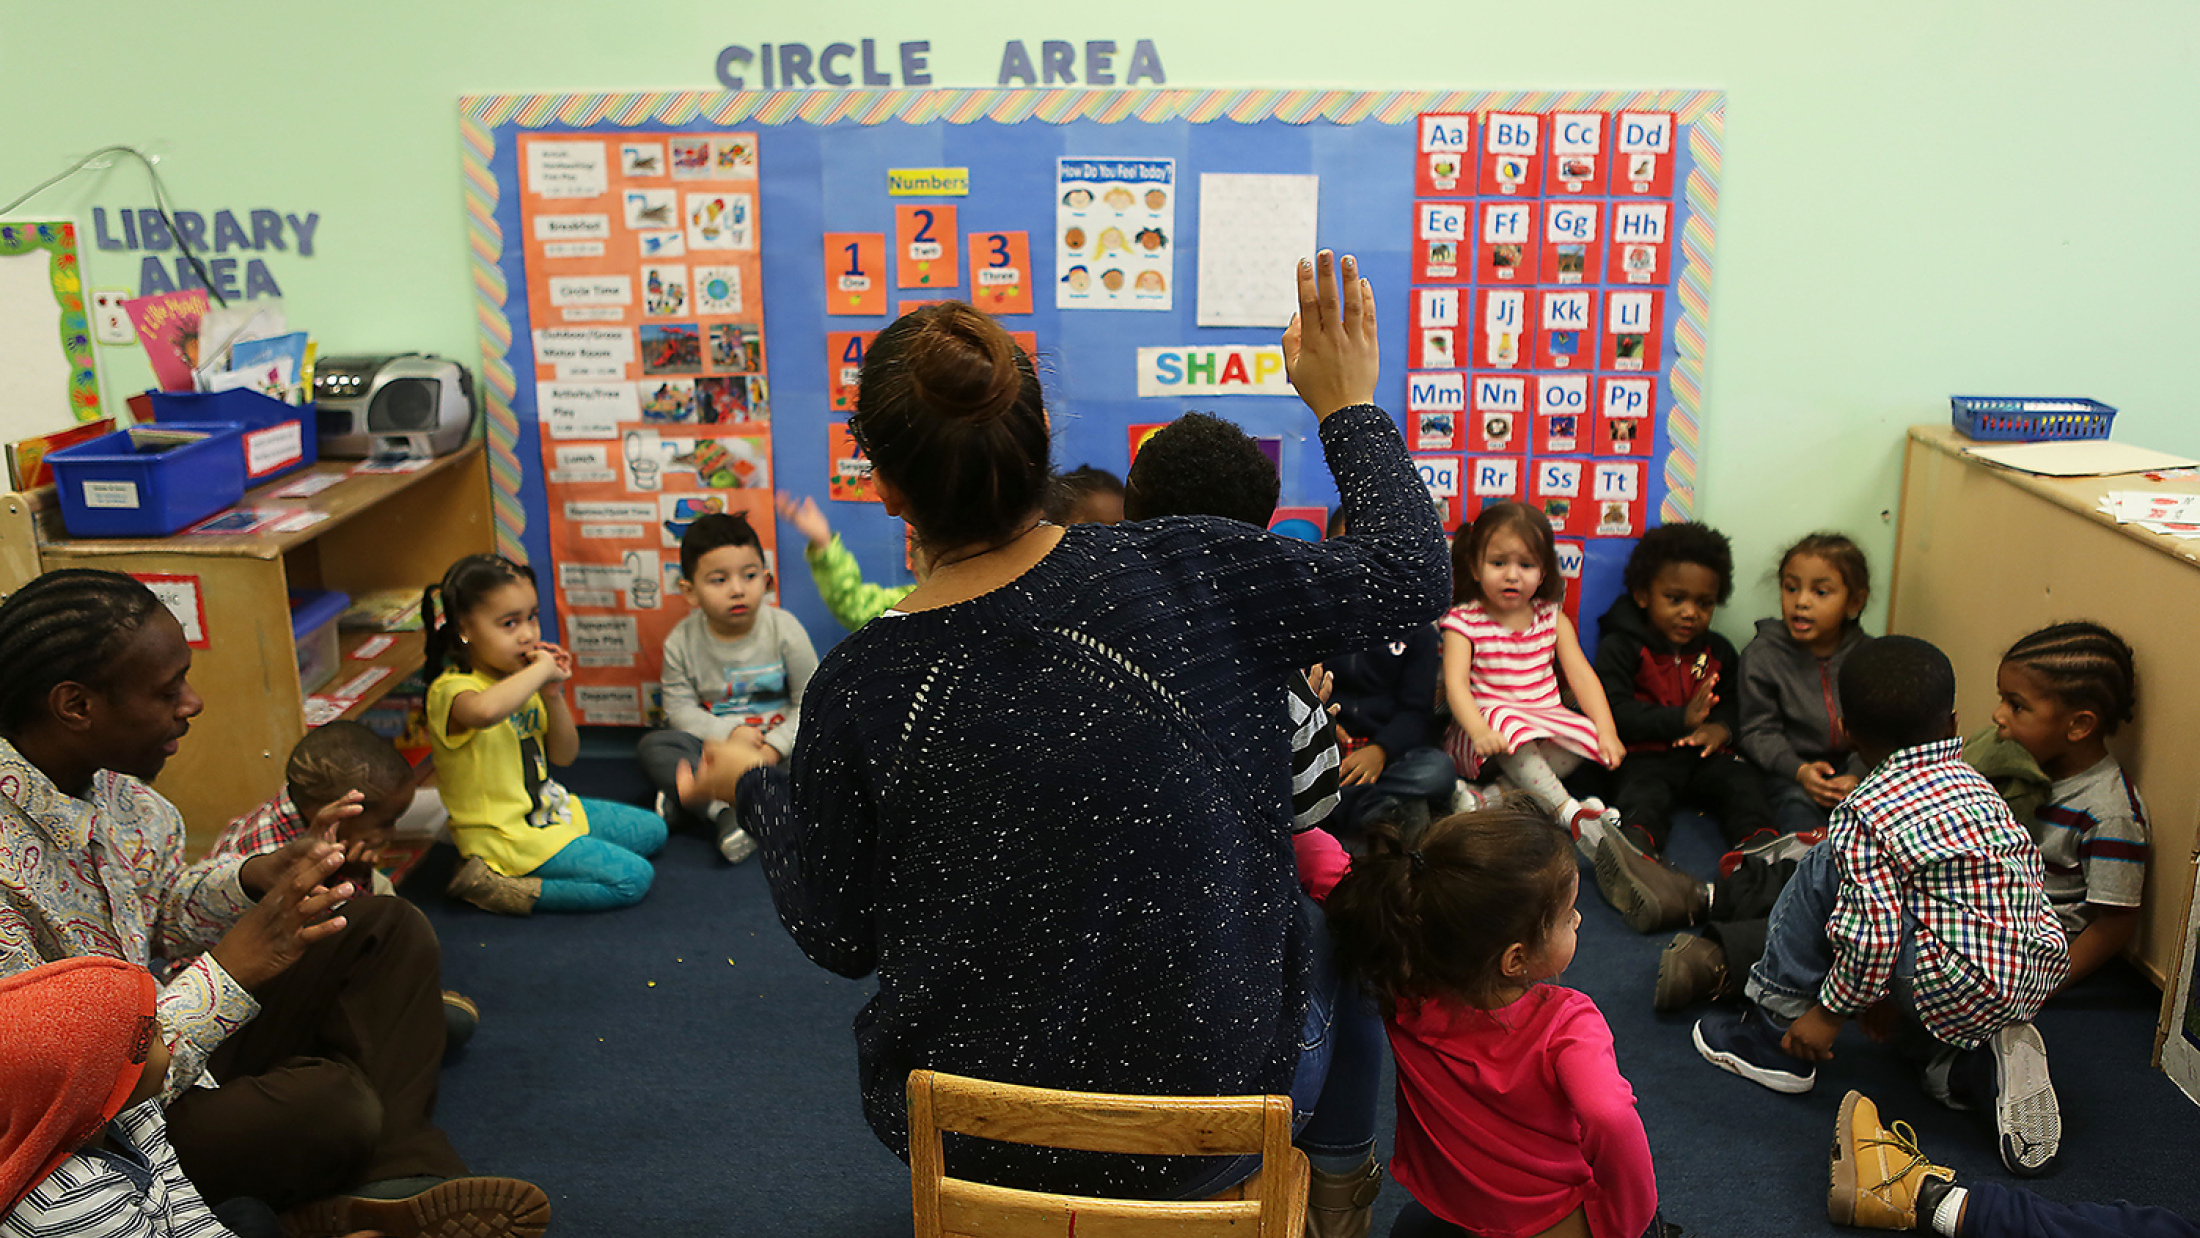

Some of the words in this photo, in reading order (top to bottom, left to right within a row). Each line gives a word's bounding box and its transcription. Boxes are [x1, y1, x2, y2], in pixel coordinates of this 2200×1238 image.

[715, 38, 933, 90] CIRCLE
[998, 39, 1167, 86] AREA
[1430, 124, 1464, 146] Aa
[1497, 123, 1531, 147] Bb
[1564, 122, 1594, 145] Cc
[1626, 123, 1662, 147] Dd
[889, 174, 969, 190] Numbers
[1060, 163, 1082, 178] How
[1083, 163, 1098, 178] Do
[1099, 163, 1117, 178] You
[1118, 163, 1138, 179] Feel
[93, 206, 320, 257] LIBRARY
[549, 221, 600, 232] Breakfast
[913, 209, 936, 243] 2
[1429, 210, 1459, 232] Ee
[1495, 212, 1519, 234] Ff
[1554, 210, 1588, 238] Gg
[1623, 213, 1657, 236] Hh
[844, 243, 865, 276] 1
[914, 247, 937, 257] Two
[988, 234, 1010, 268] 3
[139, 256, 282, 301] AREA
[843, 278, 866, 288] One
[983, 271, 1015, 280] Three
[1496, 299, 1515, 326] Jj
[1551, 299, 1582, 321] Kk
[843, 336, 864, 367] 4
[1156, 352, 1291, 385] SHAP
[1412, 384, 1461, 404] Mm
[1482, 383, 1517, 404] Nn
[1546, 386, 1582, 407] Oo
[1611, 386, 1642, 412] Pp
[564, 455, 595, 464] Lunch
[1418, 465, 1452, 490] Qq
[1481, 466, 1509, 487] Rr
[1546, 466, 1573, 488] Ss
[1602, 471, 1628, 492] Tt
[1559, 555, 1582, 570] w
